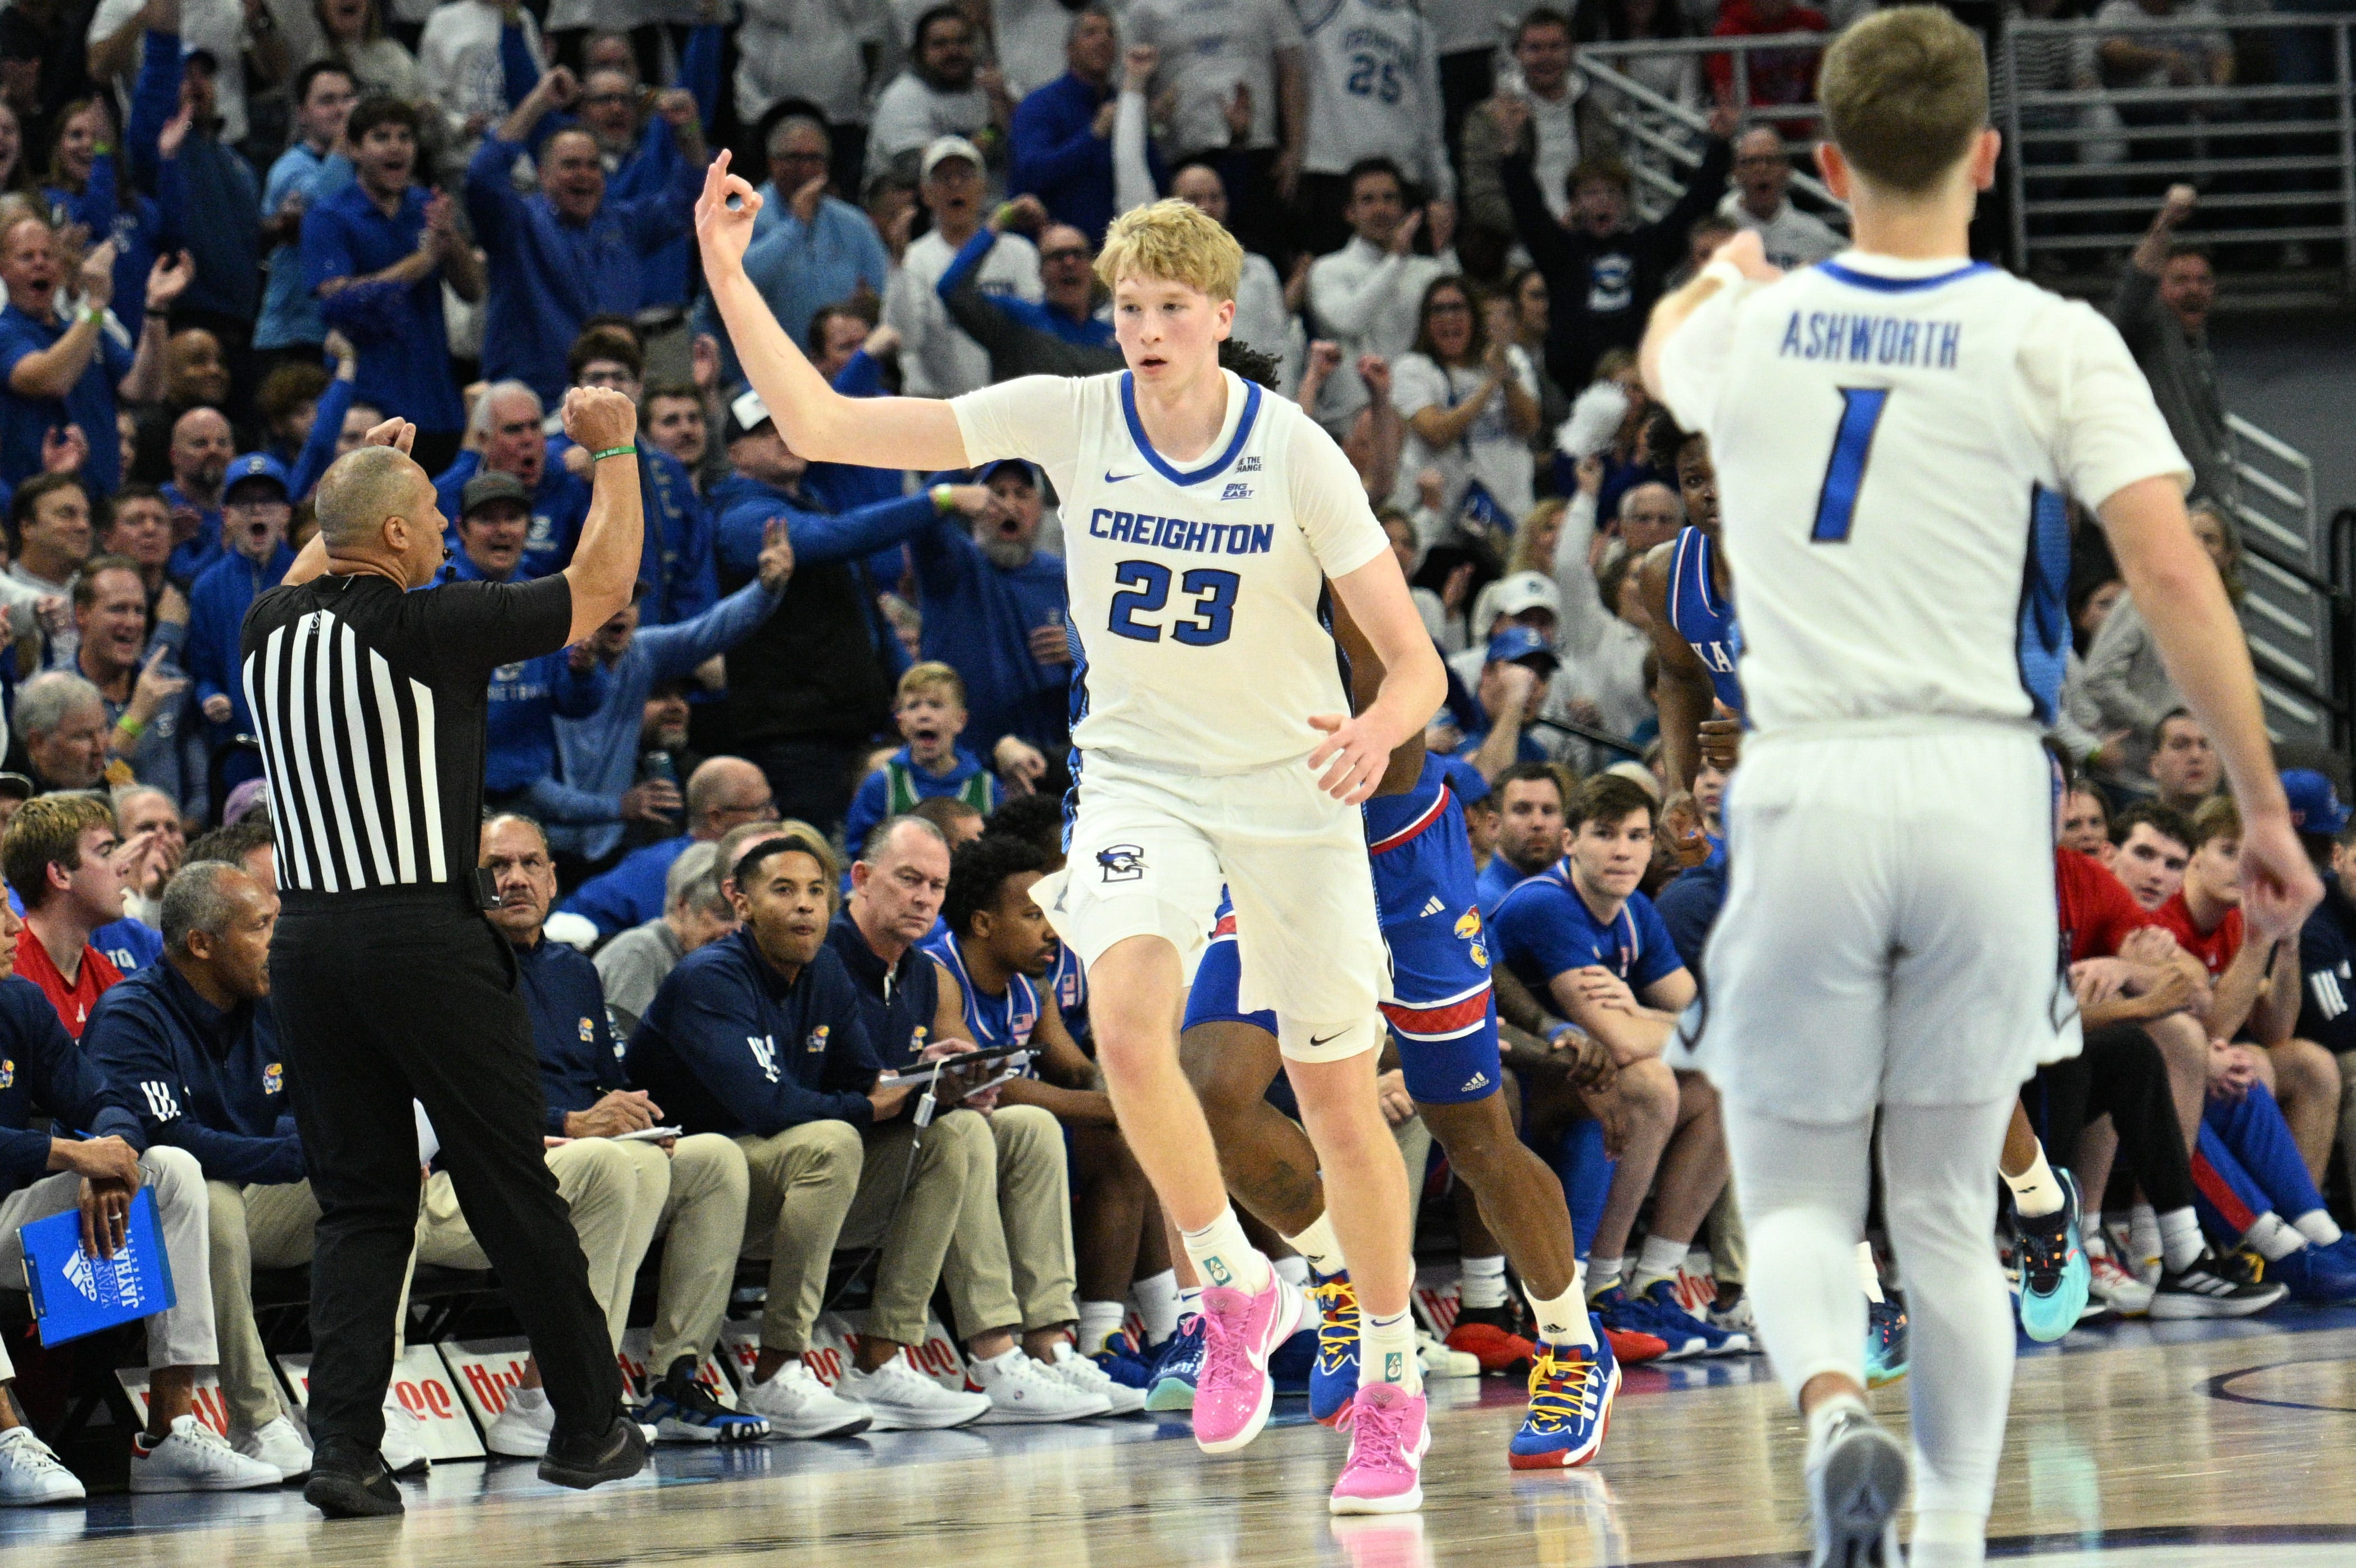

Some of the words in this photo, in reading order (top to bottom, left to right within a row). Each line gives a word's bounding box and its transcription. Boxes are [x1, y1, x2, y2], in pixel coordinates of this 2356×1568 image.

[1780, 310, 1962, 370] ASHWORTH
[1811, 385, 1892, 544] 1
[1089, 508, 1274, 555] CREIGHTON
[1107, 560, 1241, 647] 23
[1461, 1079, 1489, 1092] adidas
[112, 1247, 139, 1308] JAYHA
